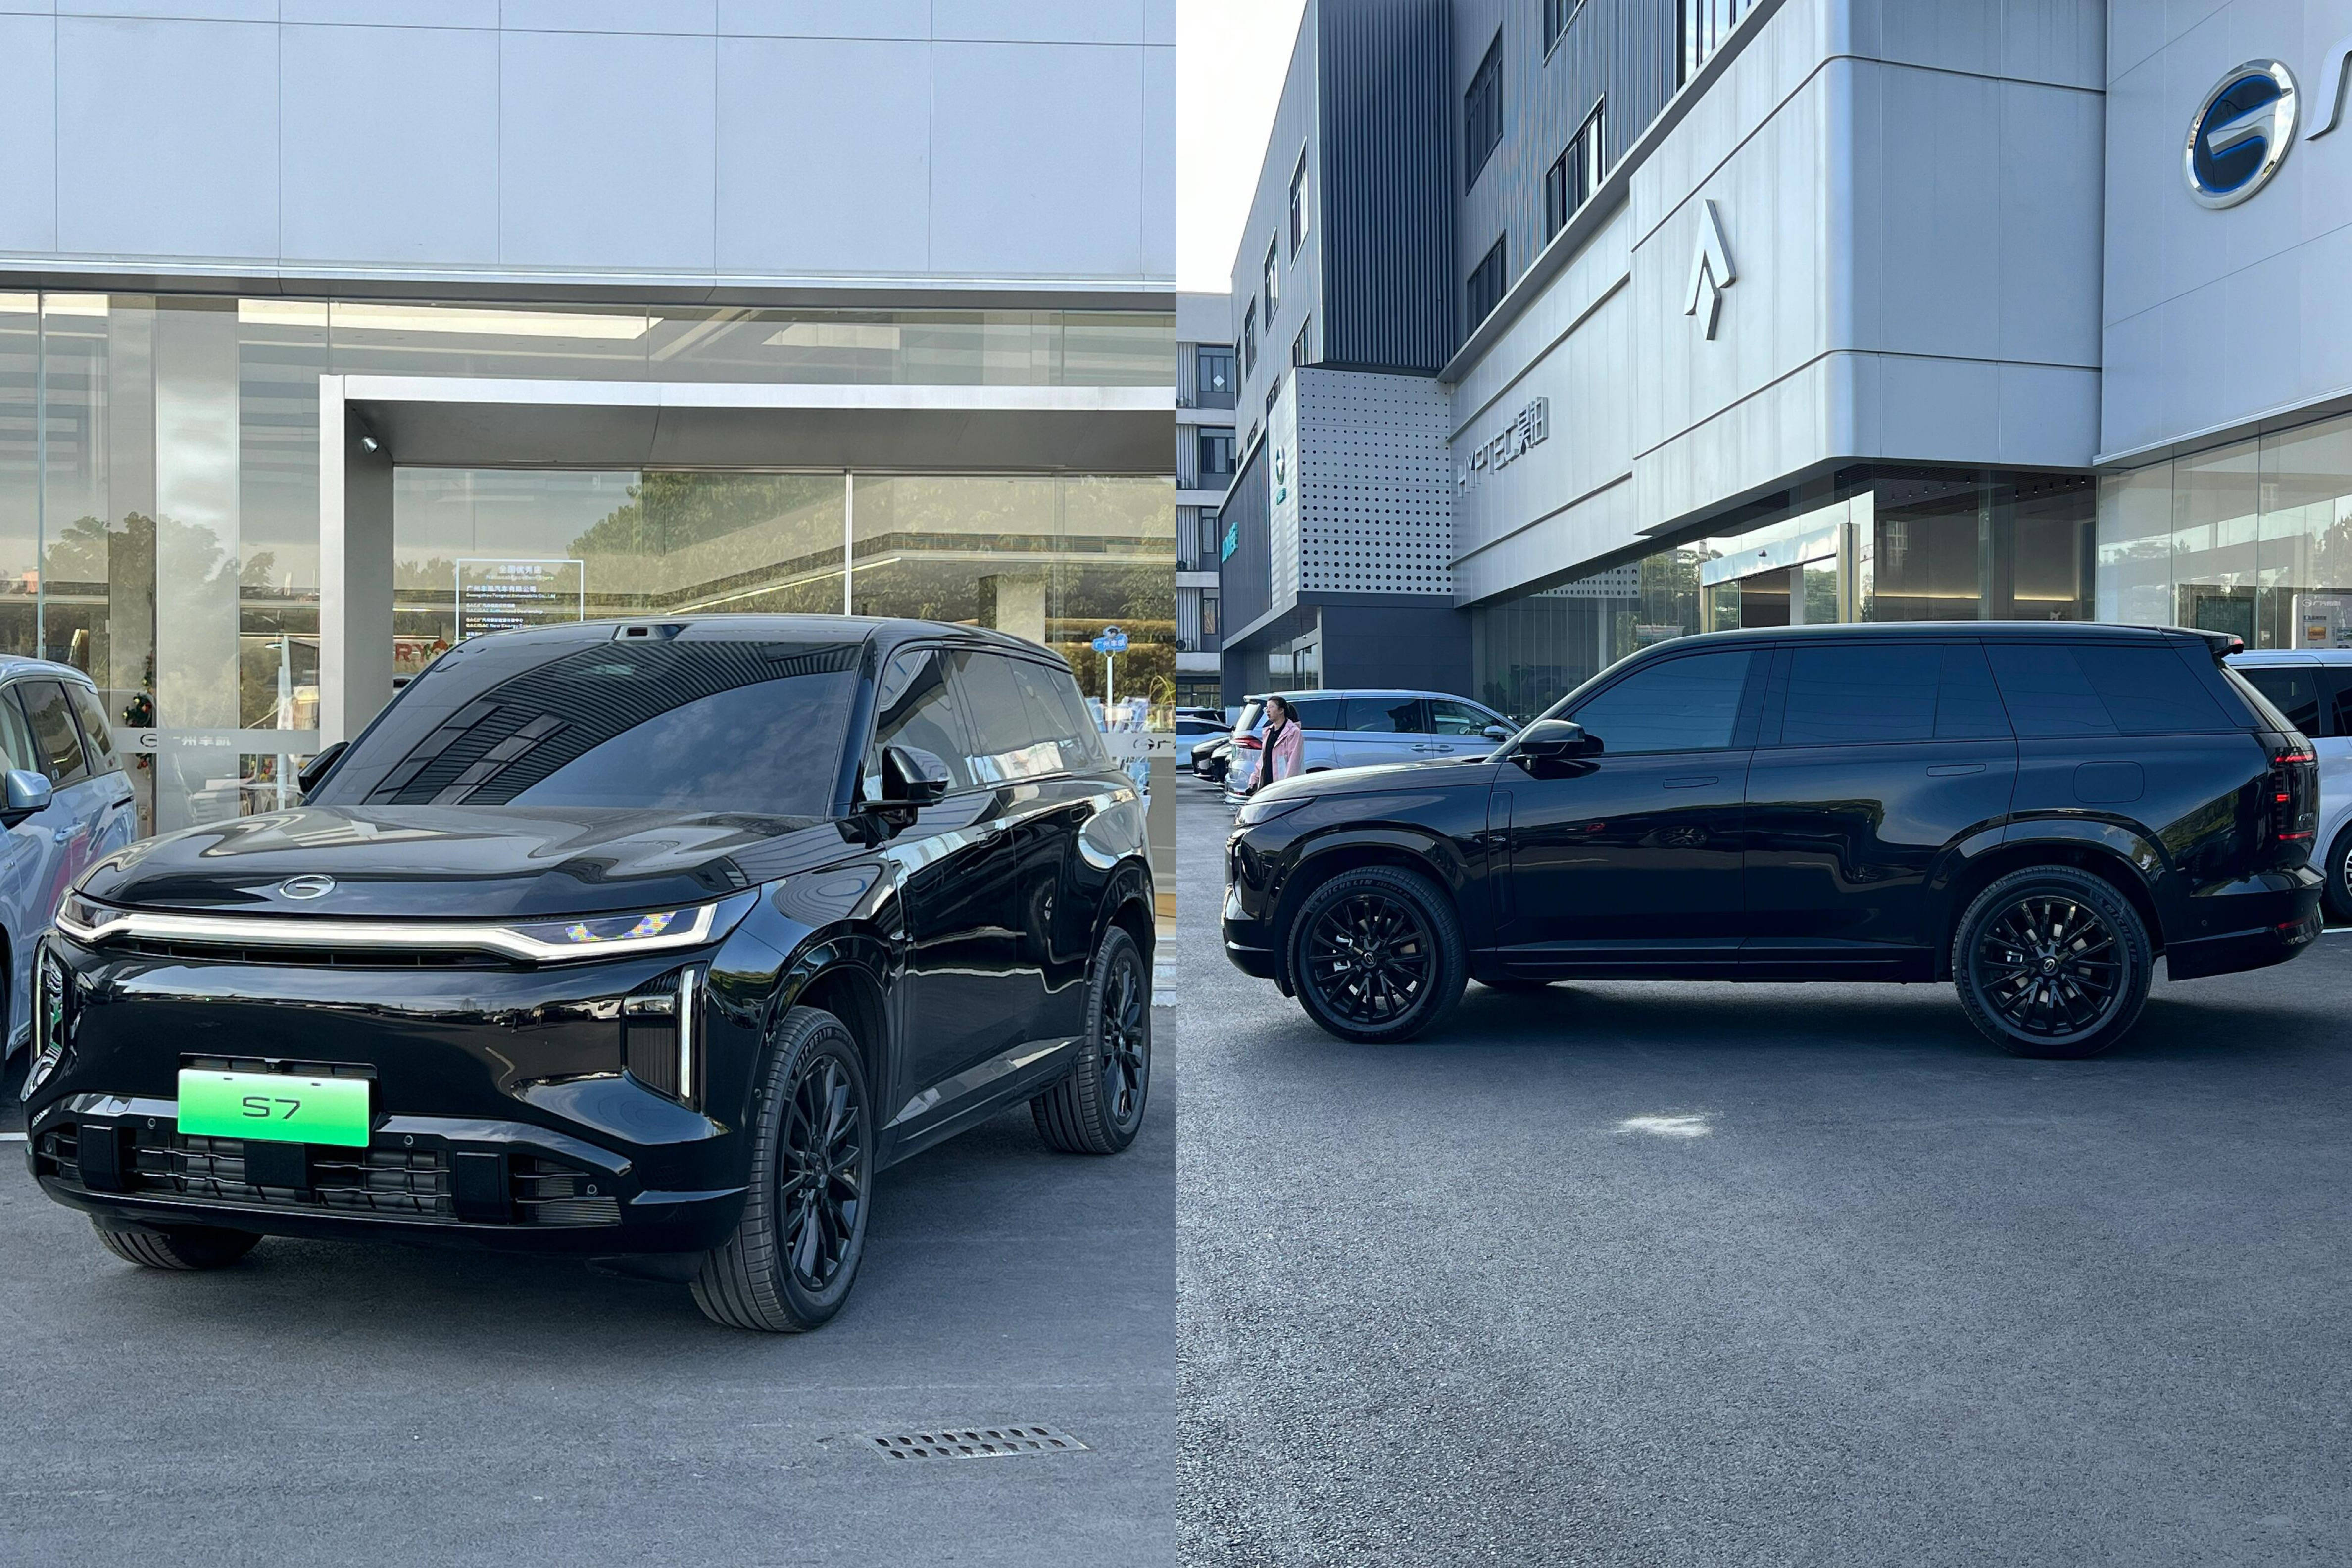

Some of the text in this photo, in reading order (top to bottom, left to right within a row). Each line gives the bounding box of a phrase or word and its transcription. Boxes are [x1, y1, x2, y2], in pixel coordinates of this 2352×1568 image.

[1457, 417, 1519, 498] HYPTEC
[1320, 879, 1373, 902] MICHELIN
[2105, 904, 2138, 963] MICHELIN
[795, 1027, 833, 1077] MICHELIN
[242, 1096, 301, 1120] S7
